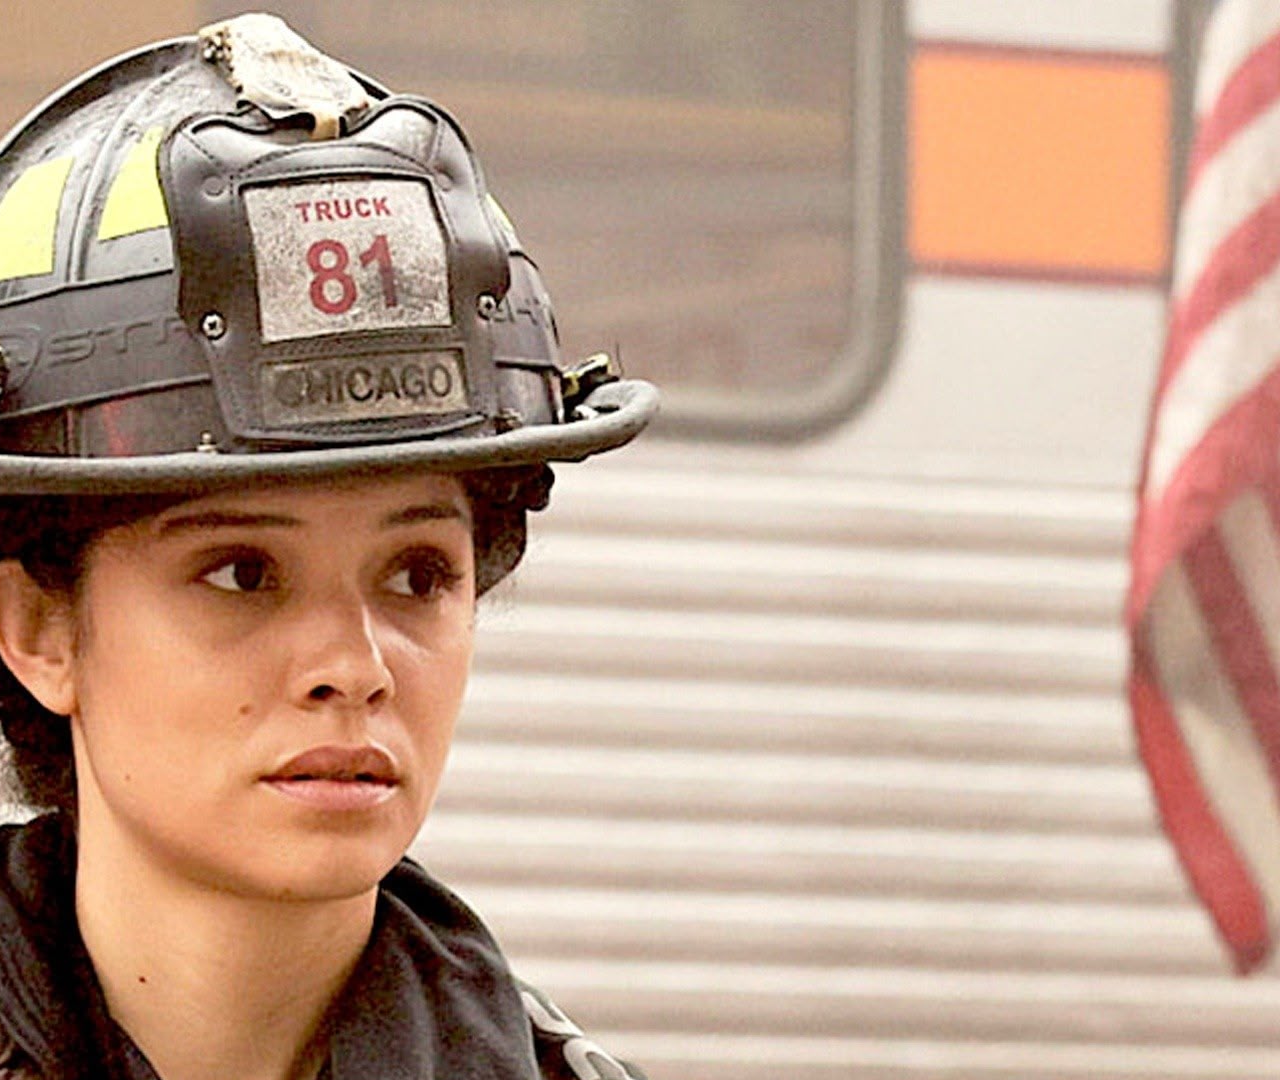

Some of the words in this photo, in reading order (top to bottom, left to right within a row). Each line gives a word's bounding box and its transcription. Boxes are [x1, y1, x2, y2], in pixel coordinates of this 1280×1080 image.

[296, 197, 391, 222] TRUCK
[307, 235, 397, 314] 81
[273, 364, 453, 408] CHICAGO
